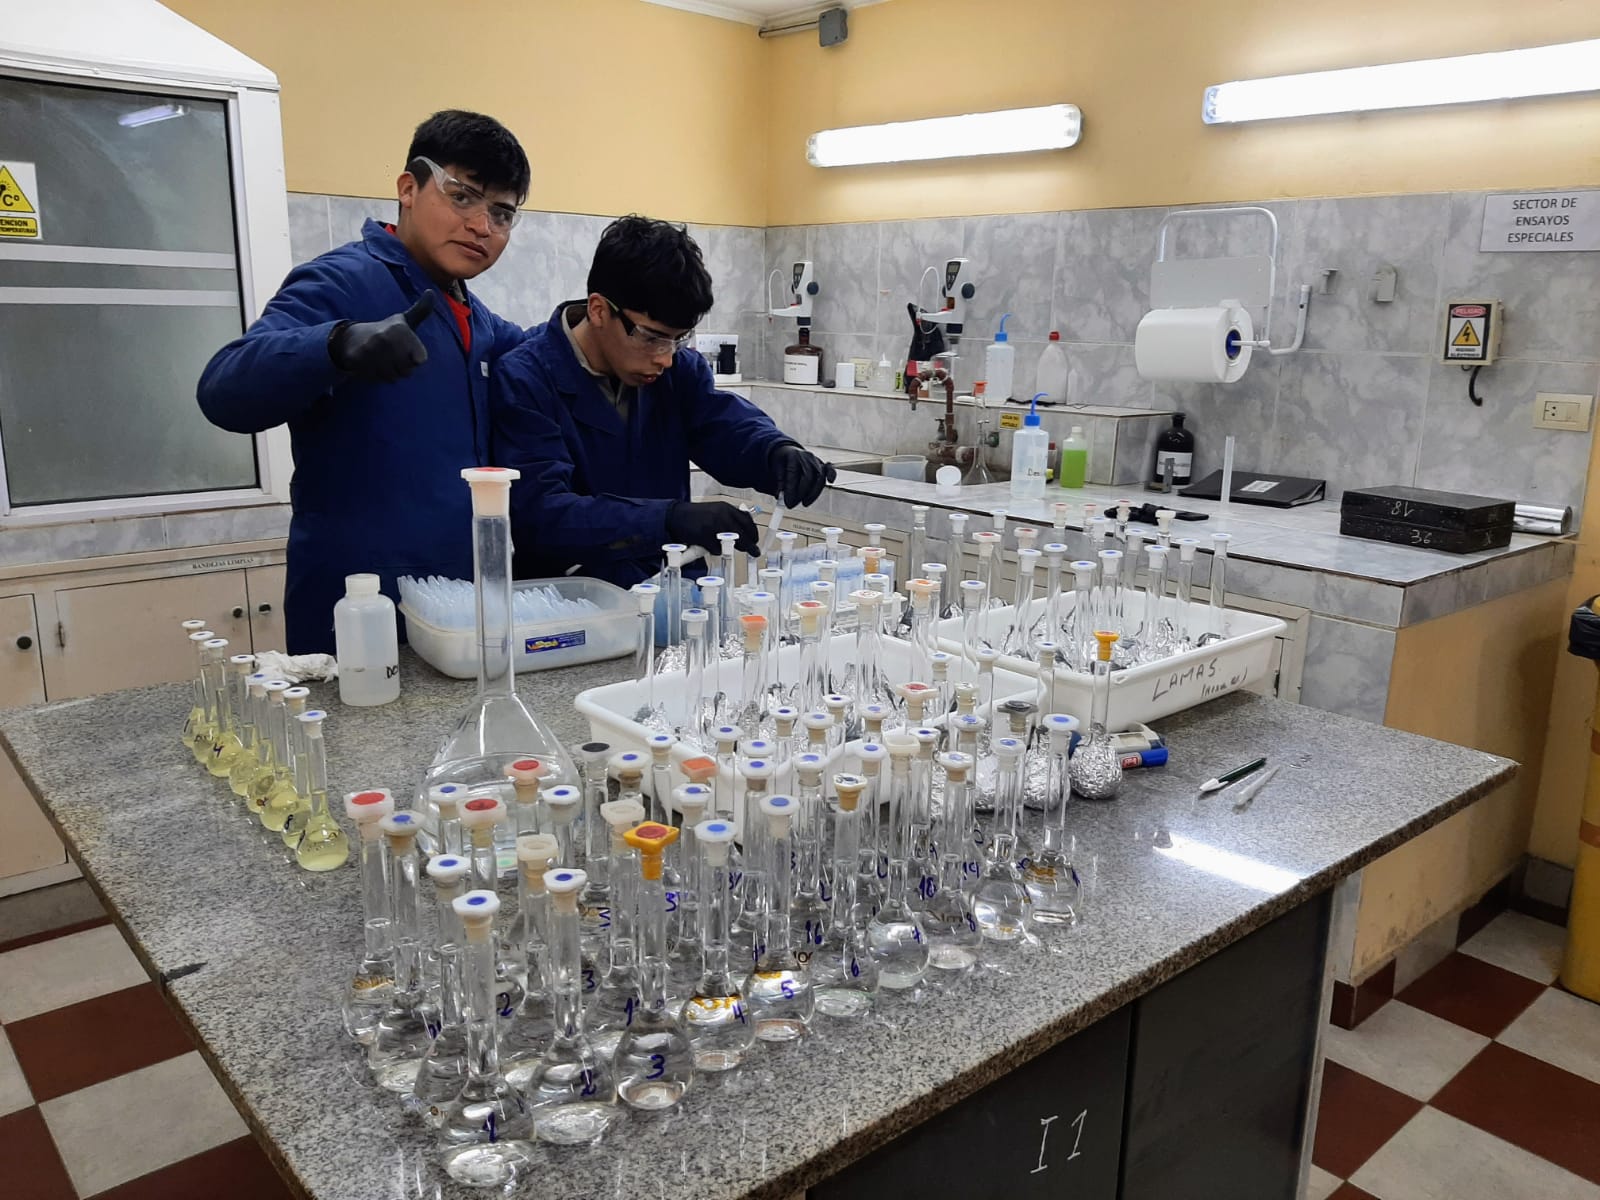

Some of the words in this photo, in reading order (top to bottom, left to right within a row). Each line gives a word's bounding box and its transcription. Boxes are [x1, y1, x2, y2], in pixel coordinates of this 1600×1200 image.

[1512, 199, 1558, 210] SECTOR
[1561, 197, 1578, 209] DE
[1515, 215, 1570, 226] ENSAYOS
[1507, 231, 1574, 243] ESPECIALES
[1152, 657, 1218, 702] LAMAS
[851, 957, 860, 977] 6
[781, 979, 794, 999] 5
[733, 1003, 745, 1024] 4
[646, 1054, 665, 1079] 3
